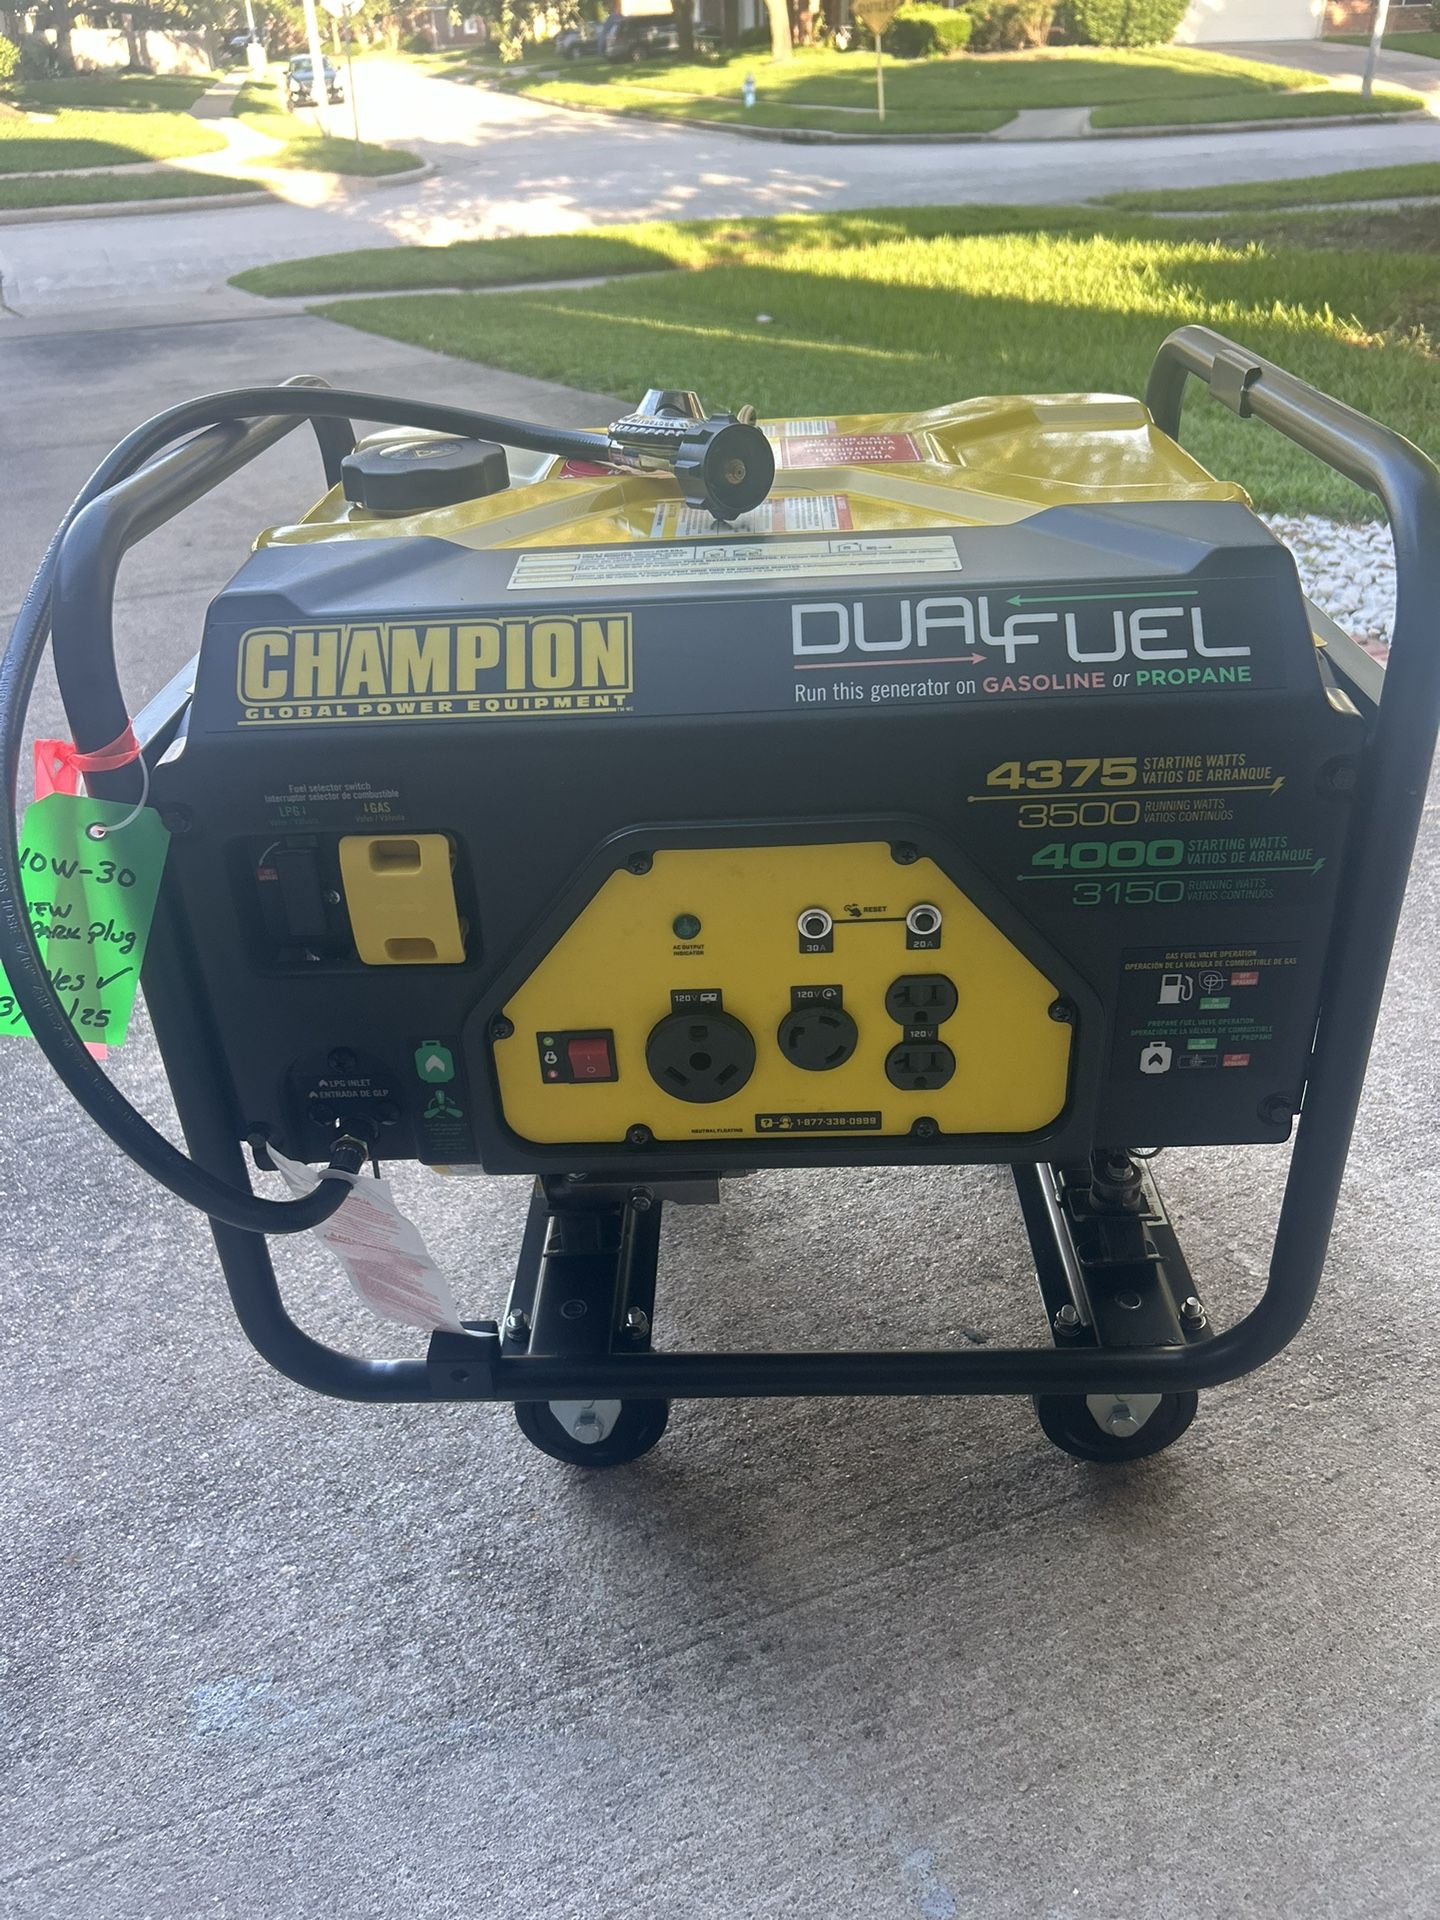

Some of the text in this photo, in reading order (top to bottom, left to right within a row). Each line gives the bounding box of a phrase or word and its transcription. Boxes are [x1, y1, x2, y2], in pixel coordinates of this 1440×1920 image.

[243, 619, 628, 700] CHAMPION
[795, 666, 1251, 702] Run this generator on GASOLINE or PROPANE
[244, 705, 348, 719] GLOBAL
[358, 702, 453, 716] POWER
[467, 695, 628, 713] EQUIPMENT
[1143, 753, 1246, 771] STARTING WATTS
[985, 756, 1138, 790] 4375
[1142, 766, 1273, 785] VATIOS DE ARRANQUE
[288, 781, 371, 793] Fuel selector switch
[308, 793, 340, 802] selector
[341, 792, 352, 800] de
[352, 789, 400, 799] combustible
[279, 805, 298, 817] LPG
[369, 801, 392, 814] GAS
[1145, 798, 1225, 812] RUNNING WATTS
[1017, 800, 1140, 829] 3500
[1144, 809, 1234, 823] VATIOS CONTINUOS
[1187, 836, 1288, 852] STARTING WATTS
[1031, 839, 1185, 870] 4000
[1187, 848, 1313, 866] VATIOS DE ARRANQUE
[1187, 878, 1266, 890] RUNNING WATTS
[1072, 880, 1185, 905] 3150
[1187, 888, 1274, 901] VATIOS CONTINUOS
[863, 905, 888, 913] RESET
[31, 920, 82, 940] PARK
[806, 943, 827, 953] 30A
[913, 940, 934, 949] 20A
[1165, 949, 1258, 961] GAS FUEL VALVE OPERATION
[1165, 961, 1176, 969] DE
[1177, 961, 1184, 969] LA
[1225, 957, 1272, 967] COMBUSTIBLE
[1273, 957, 1283, 965] DE
[1284, 957, 1297, 965] GAS
[674, 993, 698, 1003] 120V
[796, 990, 820, 1000] 120V
[909, 1029, 933, 1040] 120V
[328, 1078, 371, 1088] LPG INLET
[319, 1089, 389, 1099] ENTRADA DE GLP
